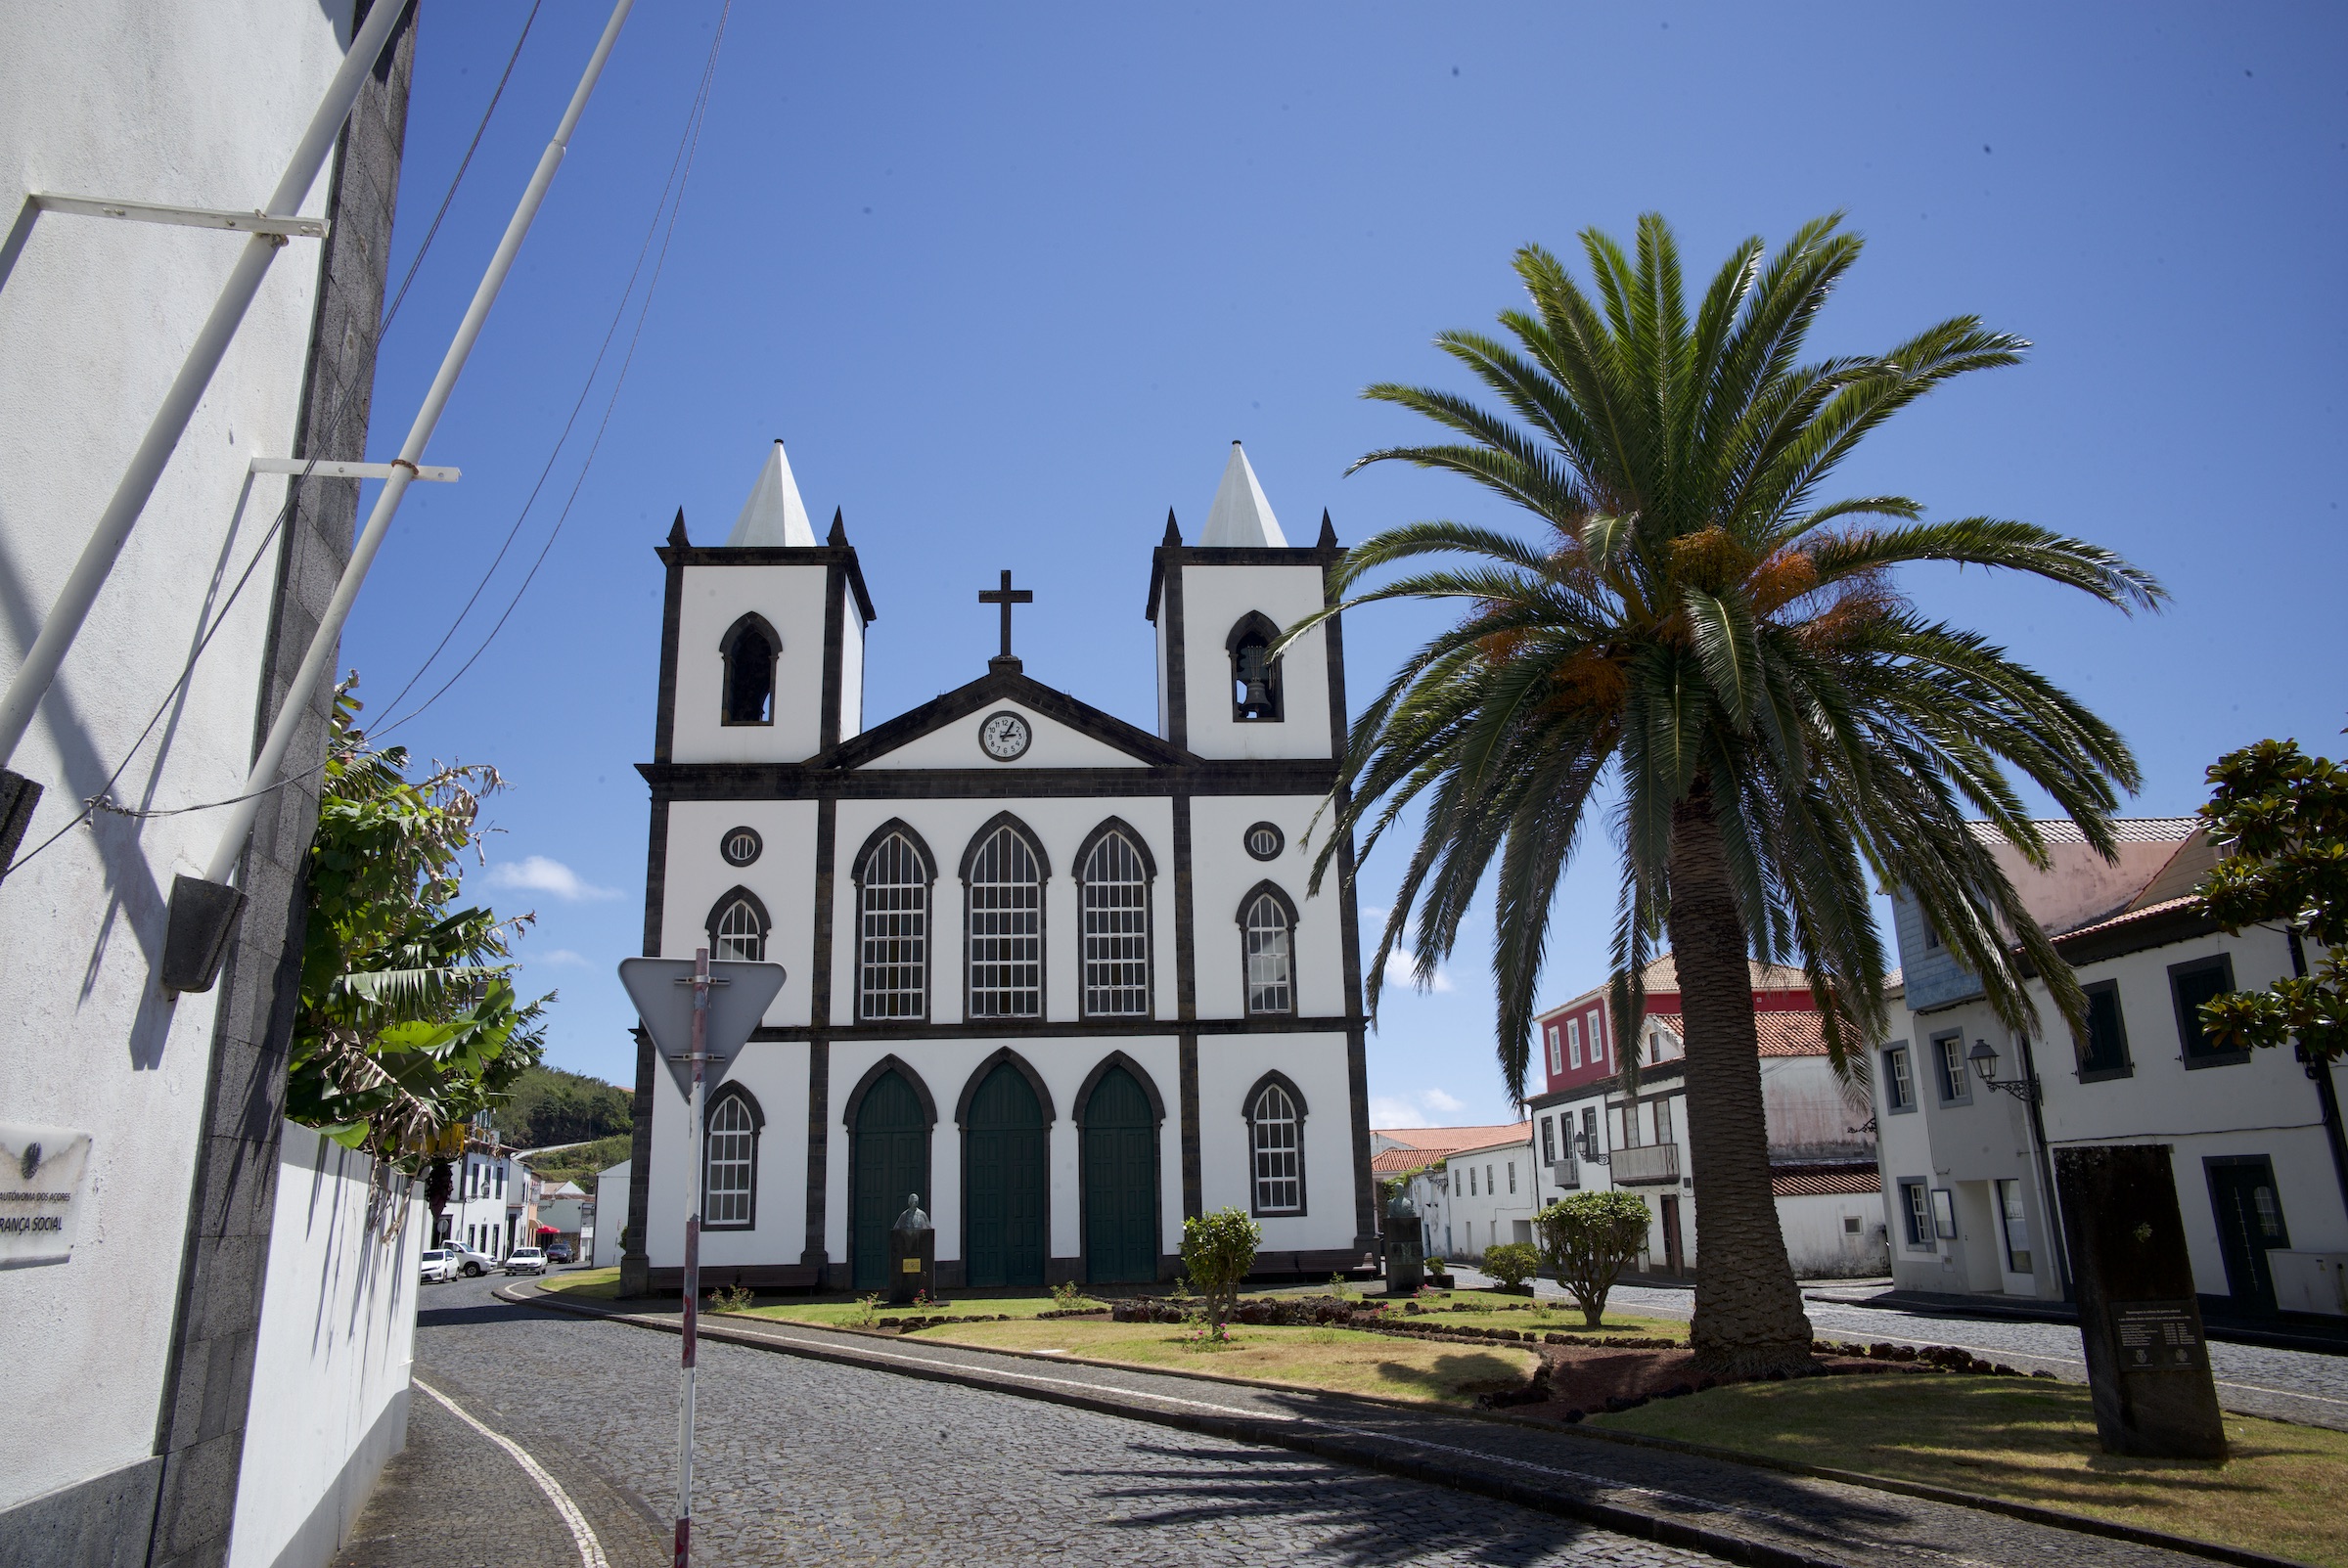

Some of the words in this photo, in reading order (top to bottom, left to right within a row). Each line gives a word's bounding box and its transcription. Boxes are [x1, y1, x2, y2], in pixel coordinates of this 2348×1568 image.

[36, 1192, 49, 1202] DOS
[49, 1192, 71, 1204] AÇORES
[32, 1216, 63, 1232] SOCIAL
